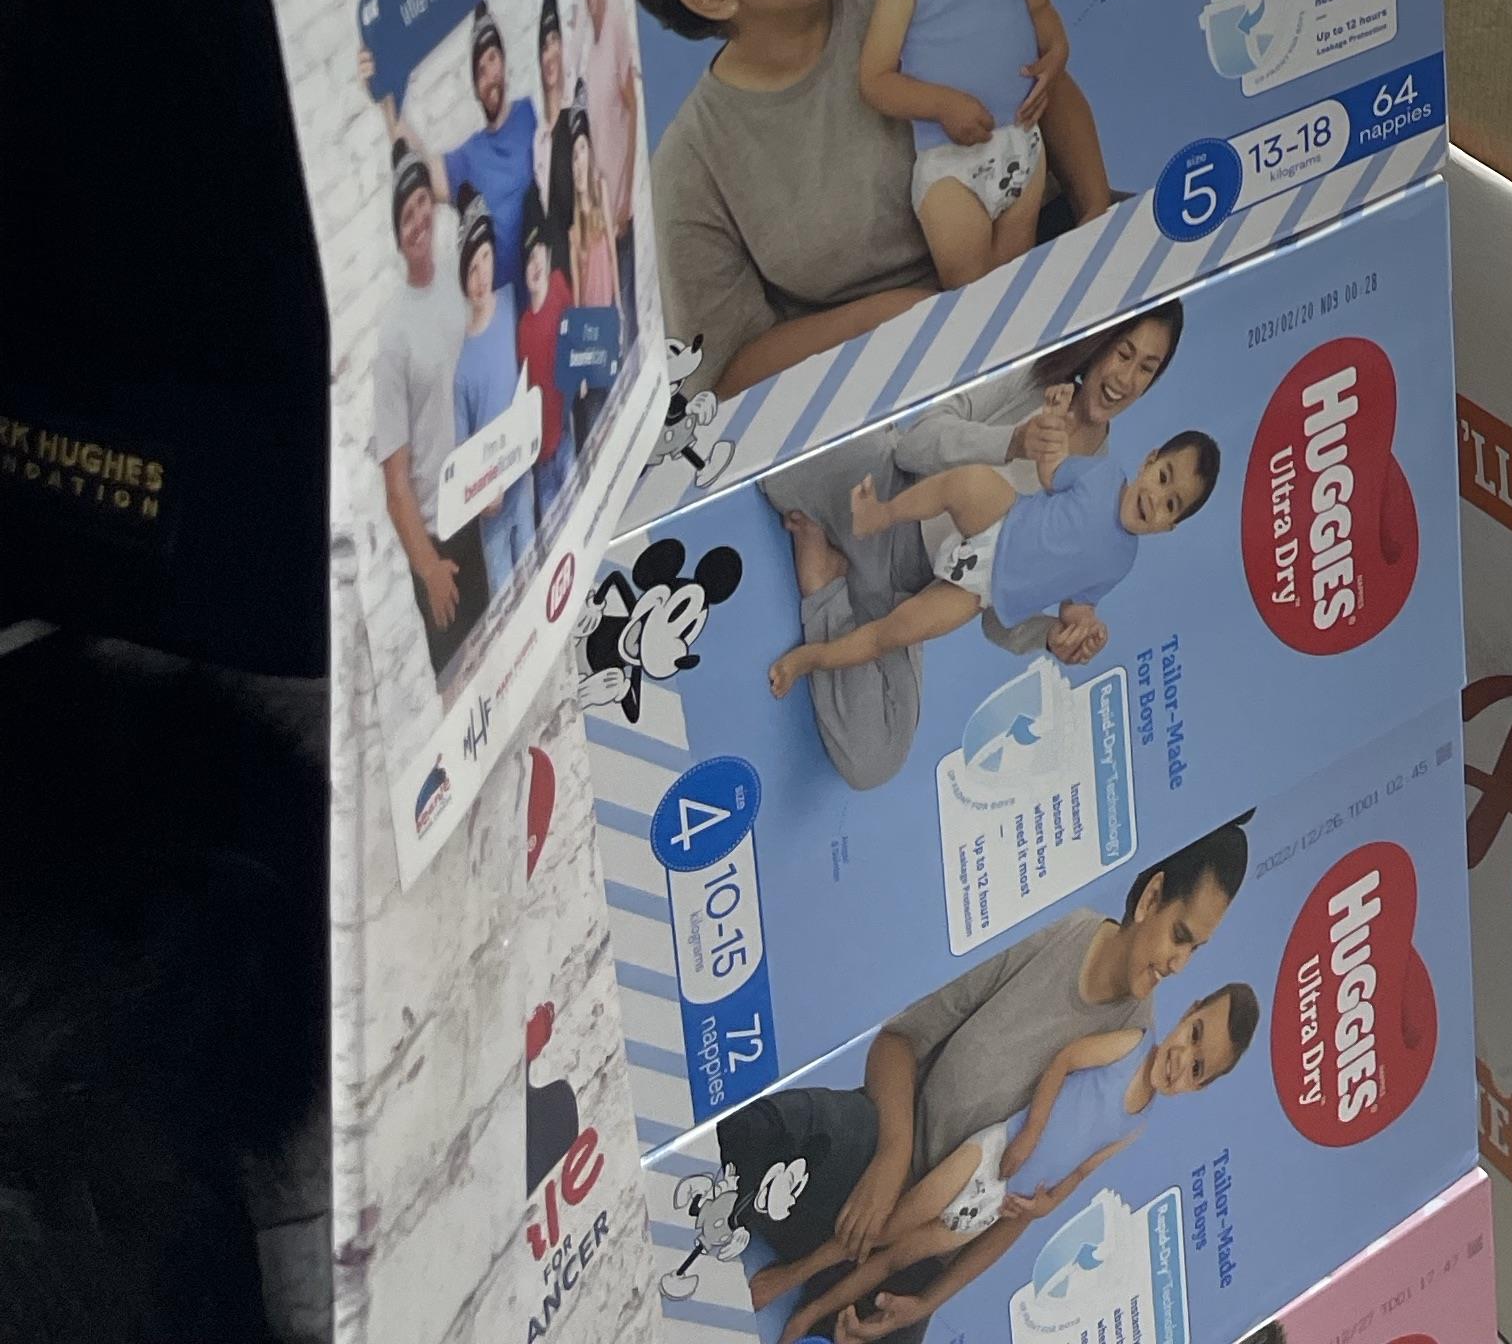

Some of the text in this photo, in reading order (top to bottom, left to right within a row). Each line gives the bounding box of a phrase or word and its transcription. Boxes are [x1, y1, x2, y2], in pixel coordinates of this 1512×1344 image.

[1316, 9, 1388, 43] Up to 12 hours
[1359, 103, 1432, 145] nappies
[1372, 74, 1418, 117] 64
[1248, 115, 1332, 174] 13-18
[1269, 154, 1321, 182] kilograms
[1181, 162, 1218, 226] 5
[1248, 306, 1314, 350] 2023/02/20
[37, 432, 163, 491] HUGHES
[1269, 444, 1298, 604] Ultra Dry
[1302, 366, 1359, 630] HUGGIES
[1160, 634, 1189, 791] Tailor-Made
[670, 798, 731, 851] 4
[704, 863, 747, 979] 10-15
[1328, 869, 1382, 1123] HUGGIES
[698, 1015, 725, 1106] nappies
[725, 1012, 764, 1074] 72
[543, 1236, 574, 1288] FOR
